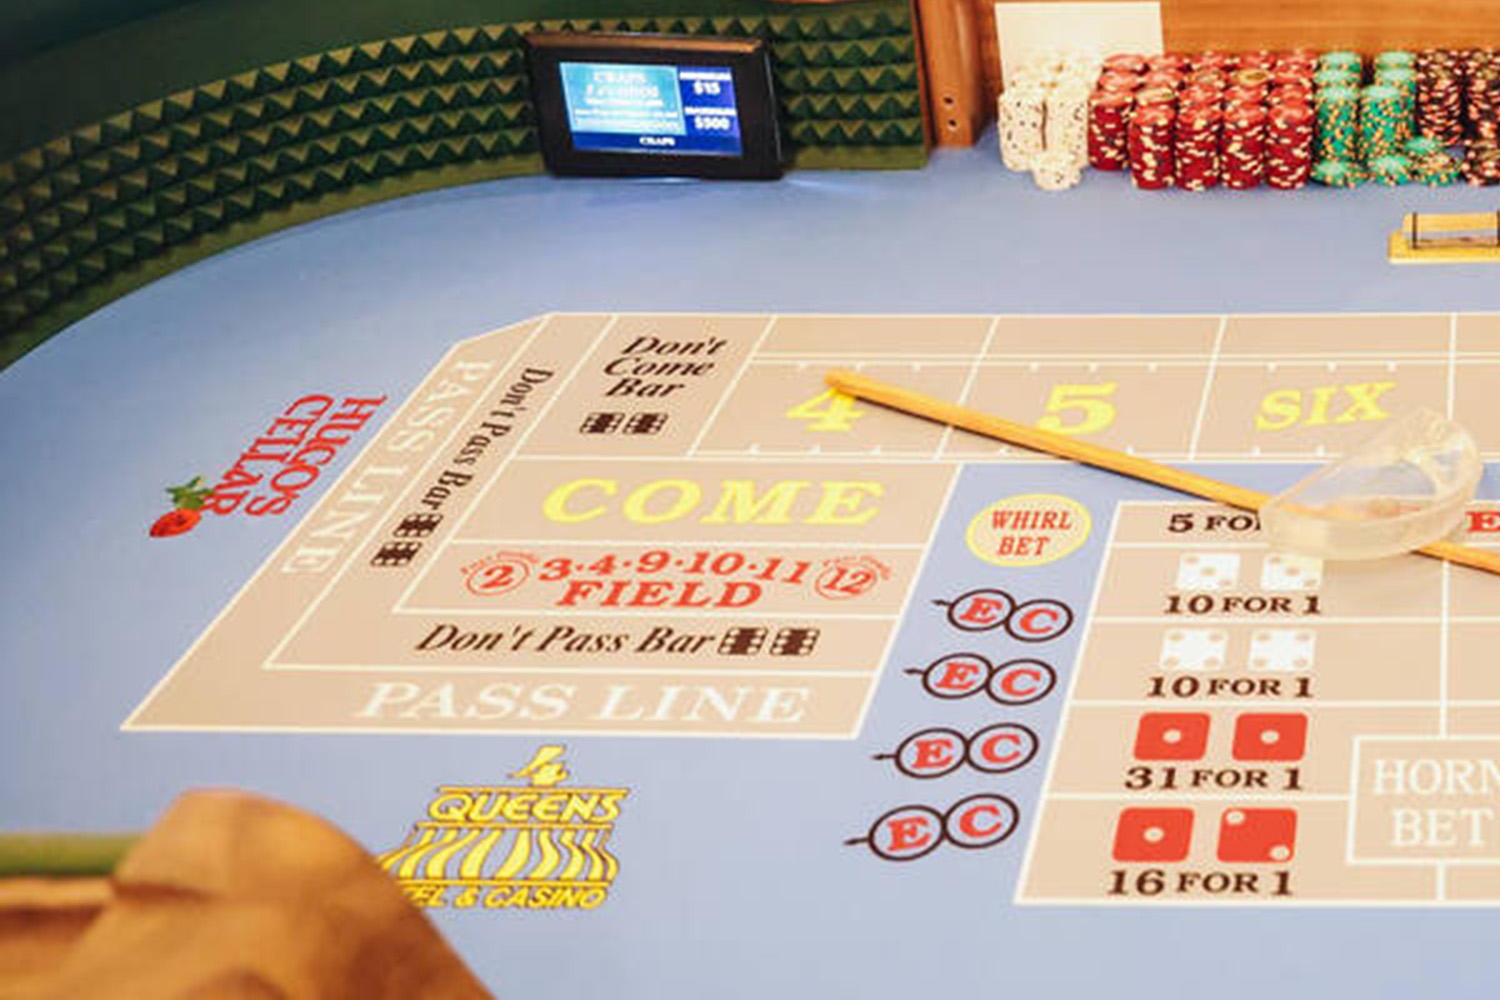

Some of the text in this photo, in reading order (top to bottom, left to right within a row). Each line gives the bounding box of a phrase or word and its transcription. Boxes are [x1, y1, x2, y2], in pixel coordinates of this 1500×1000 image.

[621, 336, 727, 356] Don't
[602, 357, 716, 378] Come
[604, 378, 685, 399] Bar
[785, 386, 867, 432] 4
[1036, 381, 1118, 436] 5
[1254, 381, 1398, 432] SIX
[421, 367, 555, 510] Don't Pass Bar
[201, 394, 334, 517] CELLAR
[282, 359, 495, 576] PASS LINE
[541, 477, 886, 526] COME
[990, 509, 1074, 531] WHIRL
[1167, 512, 1261, 533] 5 FO
[998, 535, 1051, 556] BET
[479, 565, 515, 589] 2
[823, 566, 873, 596] 12
[556, 580, 763, 609] FIELD
[1164, 594, 1322, 615] 10 FOR 1
[958, 597, 1059, 635] E C
[415, 624, 719, 655] Don't Pass Bar
[935, 661, 1042, 698] E C
[1146, 676, 1314, 699] 10 FOR 1
[357, 680, 811, 724] PASS LINE
[911, 733, 1022, 770] E C
[1123, 766, 1305, 791] 31 FOR 1
[427, 791, 624, 824] QUEENS
[886, 804, 1004, 852] E C
[1391, 807, 1496, 848] BET
[453, 885, 480, 908] &
[483, 886, 607, 910] CASINO
[1107, 869, 1297, 897] 16 FOR 1
